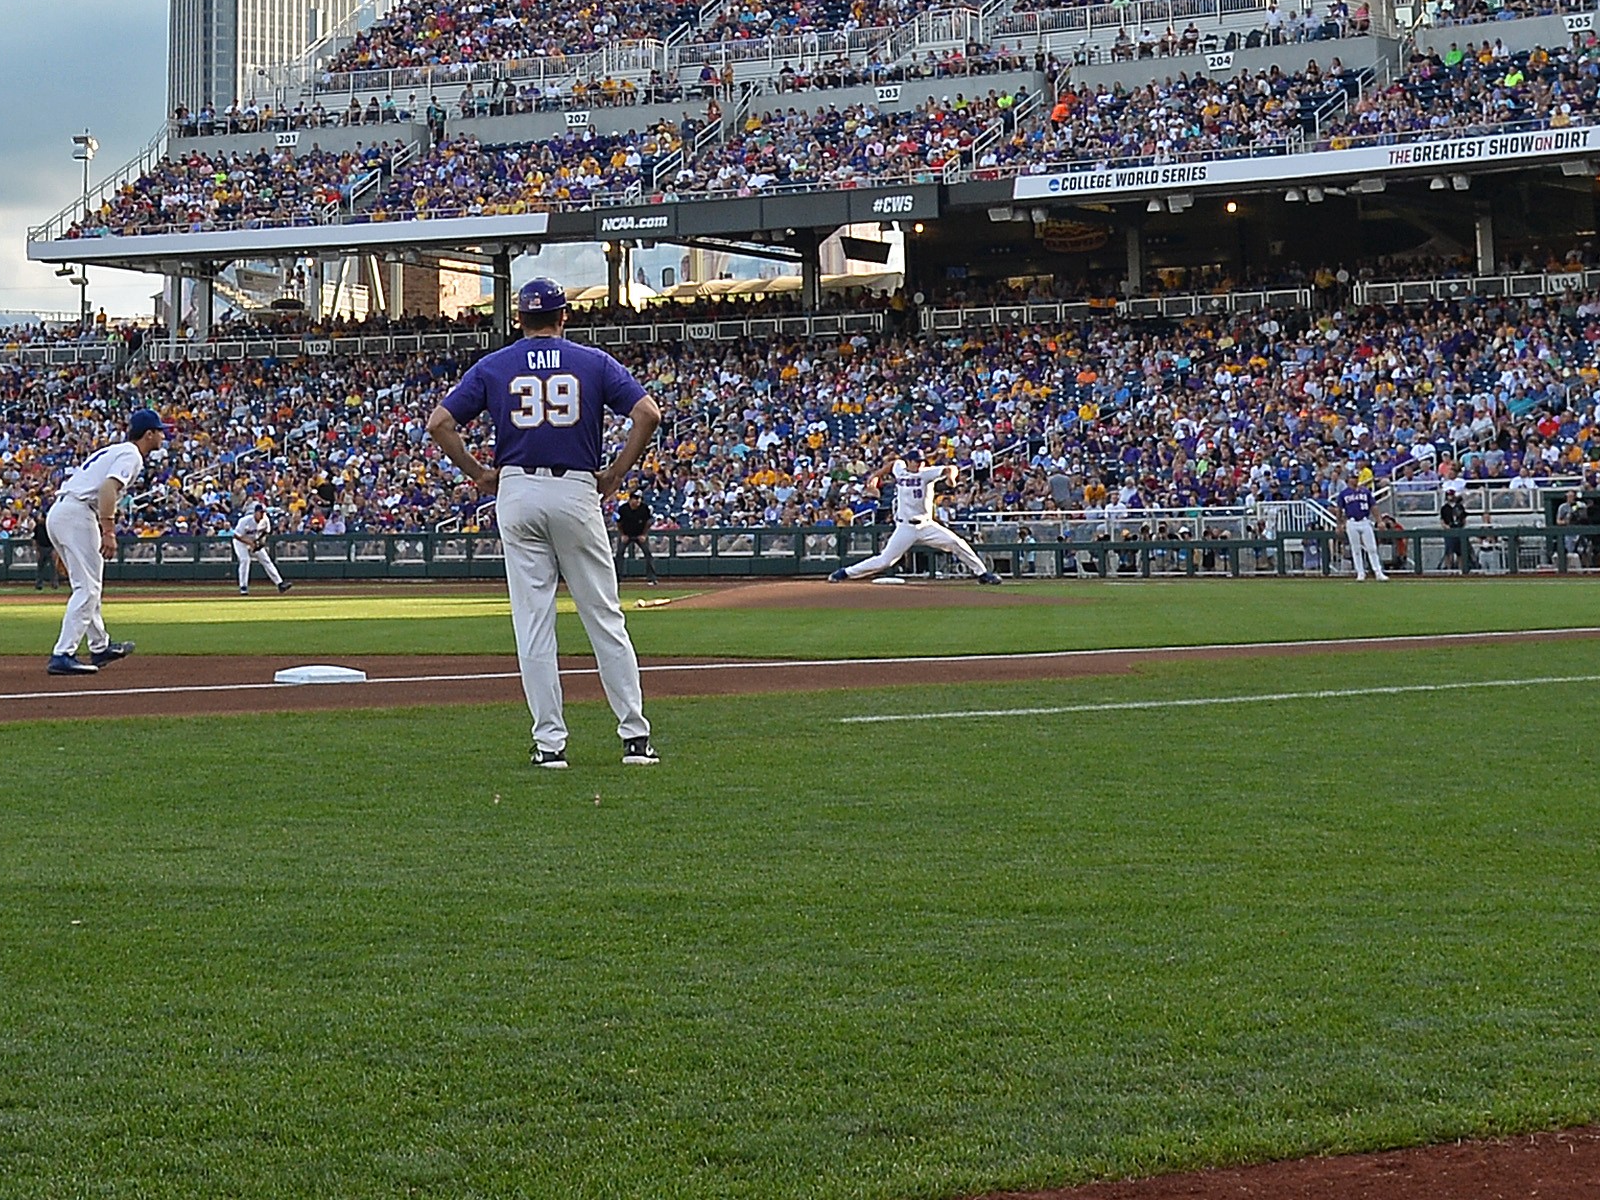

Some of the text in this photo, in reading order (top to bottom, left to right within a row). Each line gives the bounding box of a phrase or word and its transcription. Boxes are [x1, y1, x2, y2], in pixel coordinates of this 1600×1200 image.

[1568, 17, 1591, 28] 205
[1209, 56, 1231, 67] 204
[879, 89, 898, 98] 203
[568, 114, 587, 123] 202
[278, 134, 296, 143] 201
[1389, 130, 1590, 165] THE GREATEST SHOW ON DIRT
[1061, 173, 1112, 191] COLLEGE
[1115, 170, 1159, 187] WORLD
[1161, 166, 1207, 183] SERIES
[872, 195, 914, 214] #CWS
[602, 215, 668, 231] NCAA.com
[1554, 277, 1577, 288] 105
[692, 324, 710, 336] 103
[309, 341, 327, 352] 102
[527, 350, 560, 370] CAIN
[509, 373, 580, 429] 39
